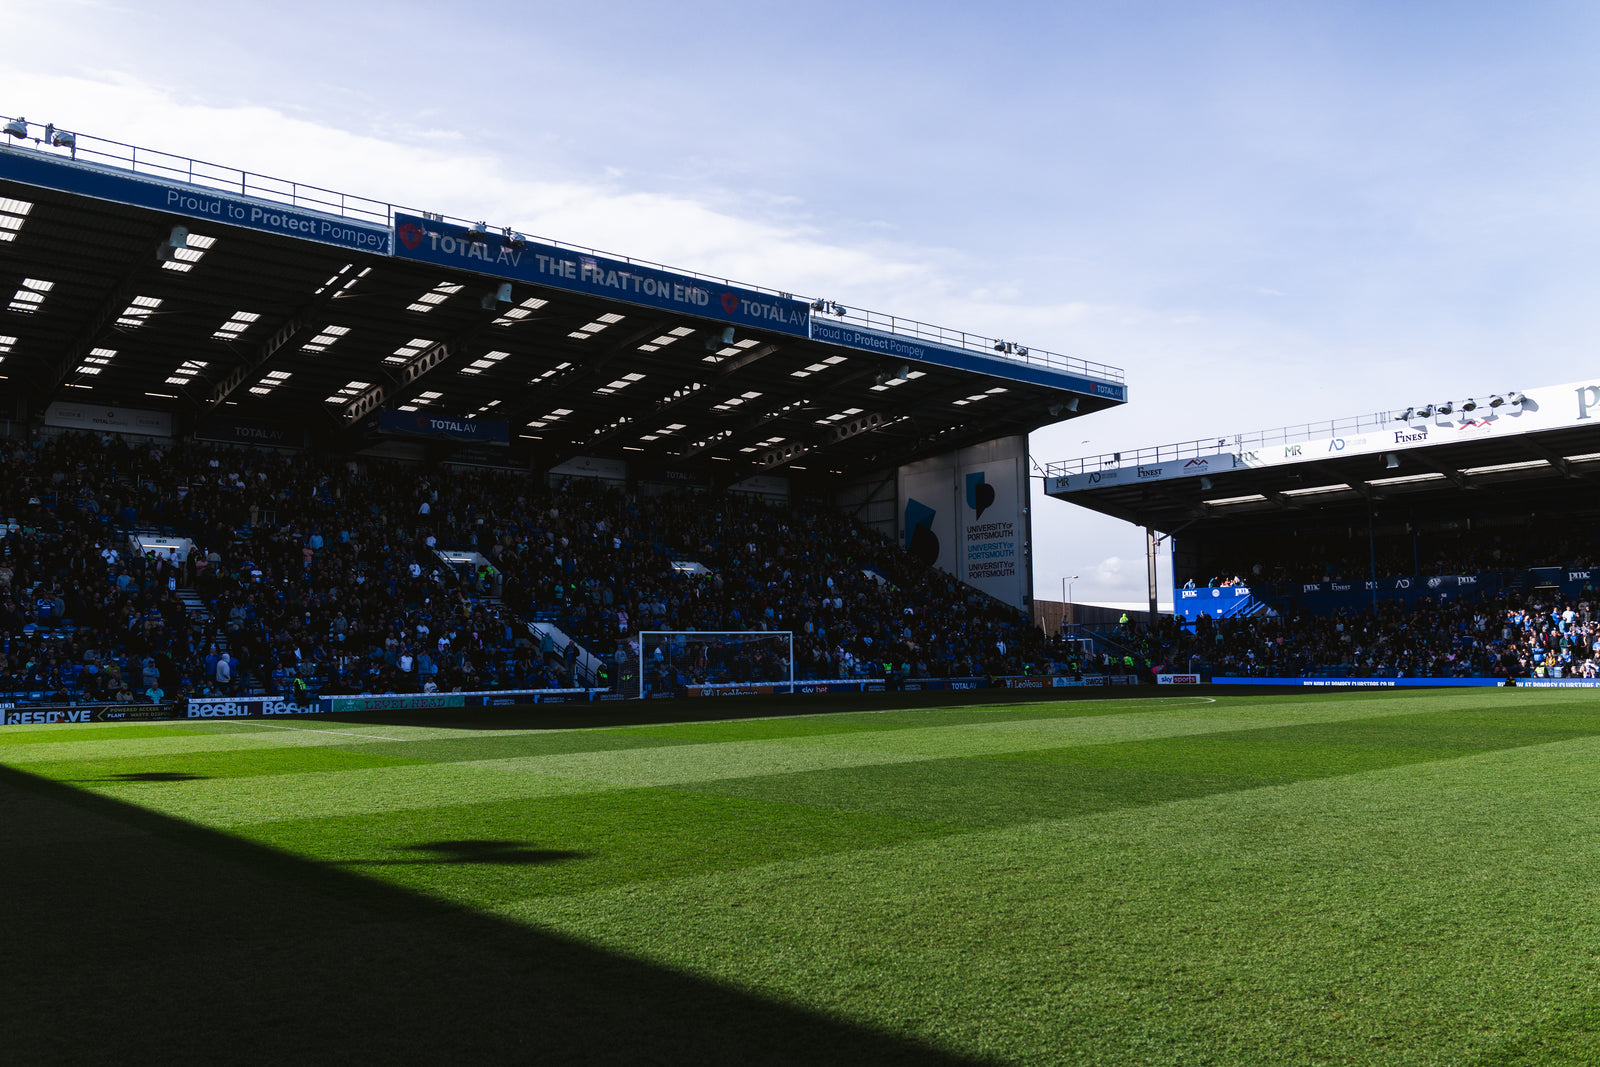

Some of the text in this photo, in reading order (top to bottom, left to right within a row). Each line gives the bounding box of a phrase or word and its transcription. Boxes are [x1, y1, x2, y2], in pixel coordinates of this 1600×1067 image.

[167, 190, 386, 251] Proud to Protect Pompey
[535, 253, 710, 307] THE FRATTON END
[813, 325, 925, 359] Proud to Protect Pompey
[1575, 385, 1600, 420] p
[967, 530, 1013, 541] PORTSMOUTH
[968, 550, 1014, 560] PORTSMOUTH
[969, 569, 1015, 579] PORTSMOUTH
[1568, 571, 1590, 582] pmc
[1457, 575, 1477, 586] pmc
[1235, 587, 1250, 596] pmc
[1303, 583, 1320, 593] pmc
[1182, 590, 1198, 599] pmc
[815, 685, 829, 693] bet
[365, 700, 407, 710] LEVEL
[411, 698, 446, 708] HEAD
[7, 710, 92, 725] RESOVE
